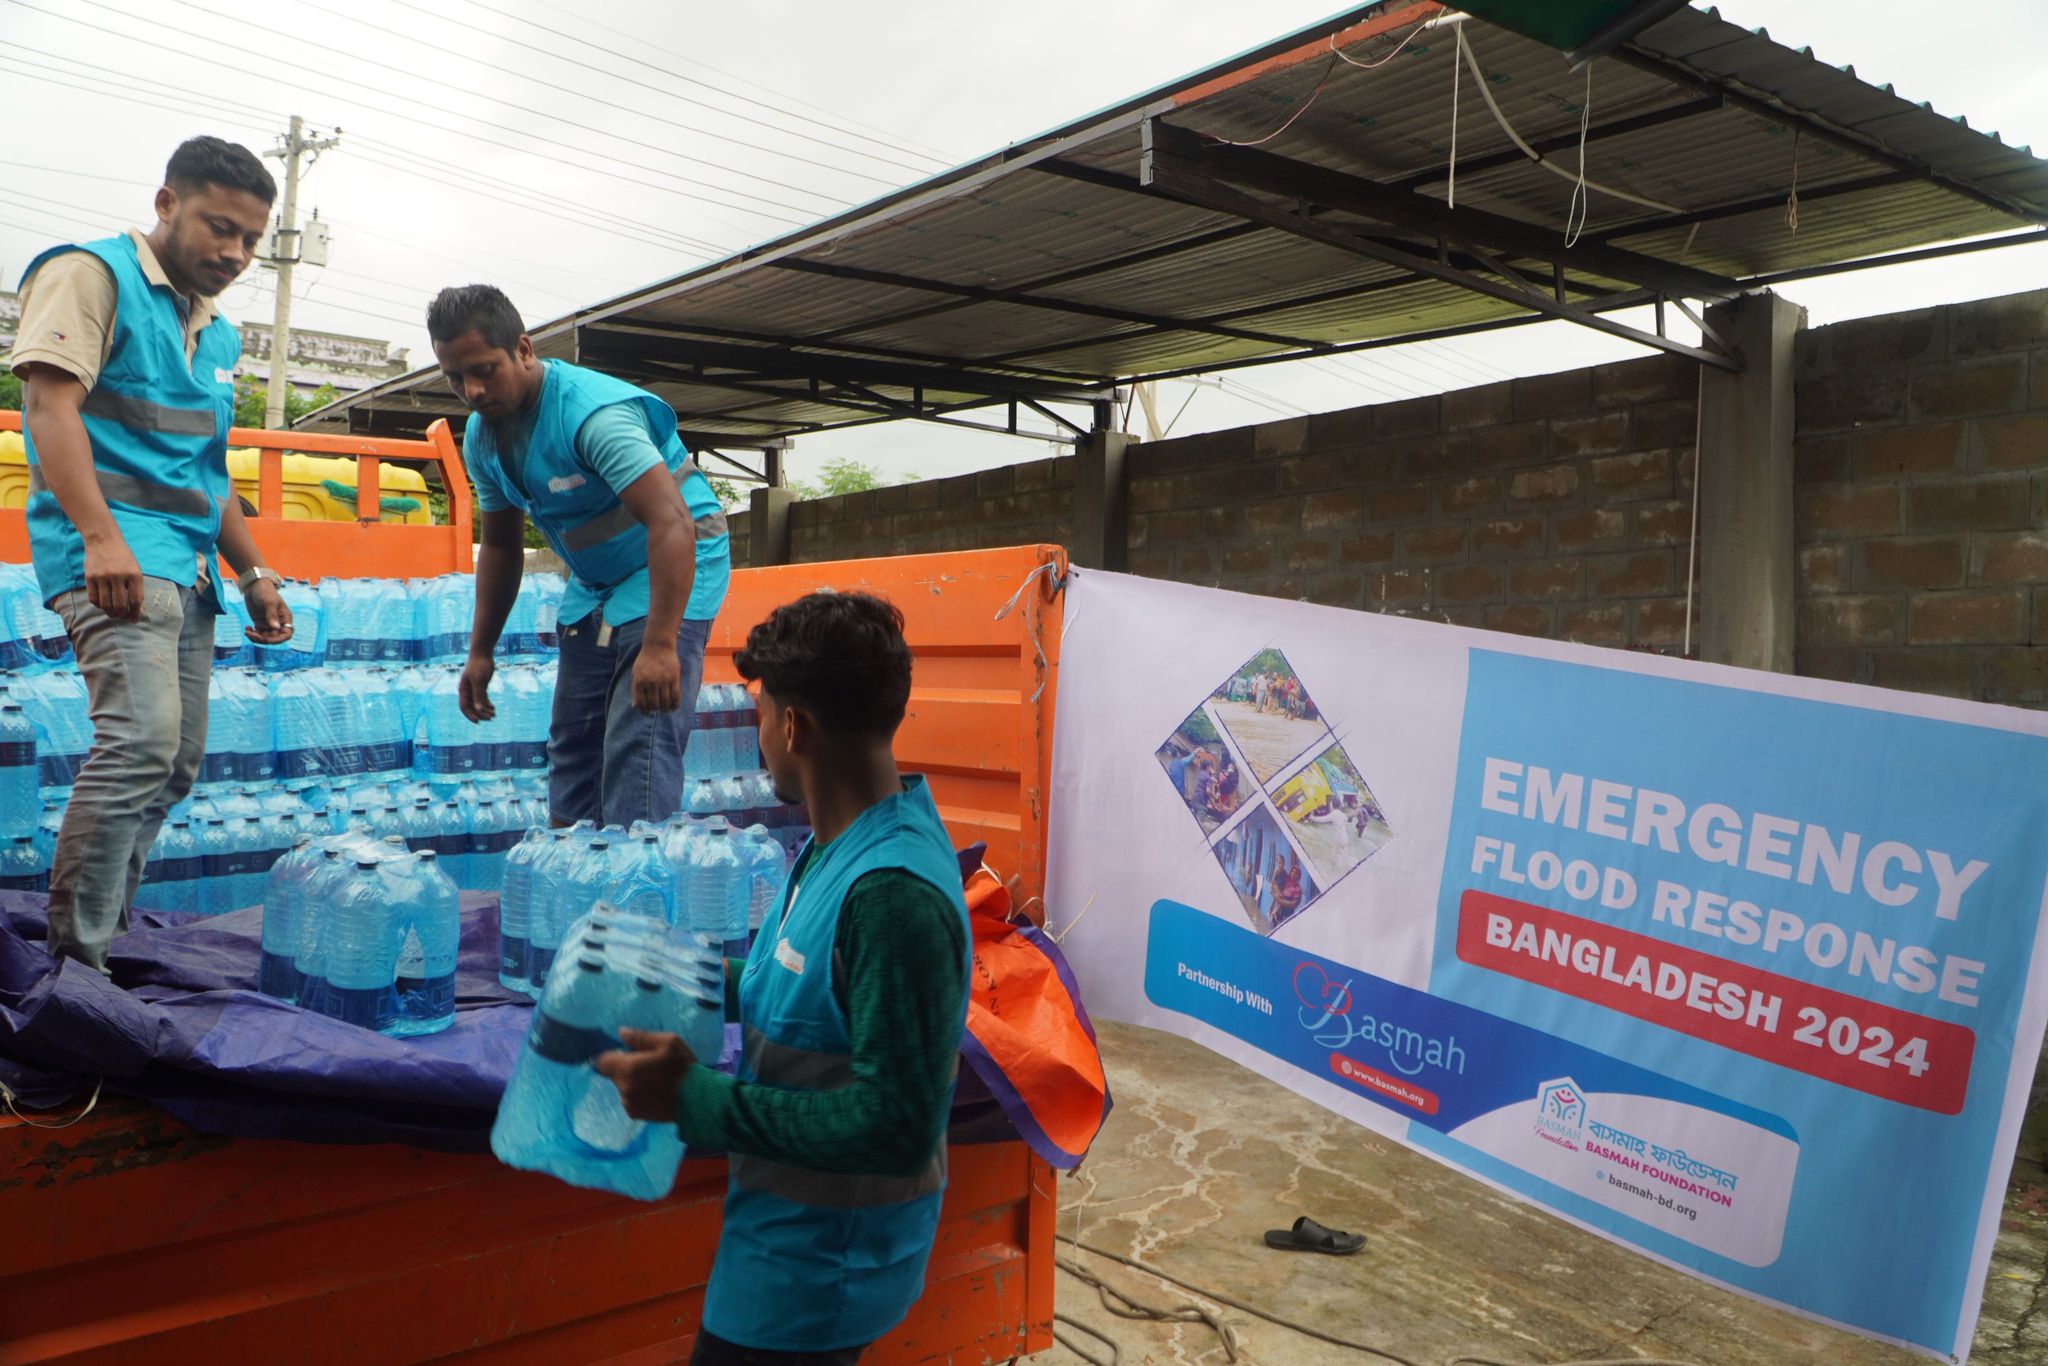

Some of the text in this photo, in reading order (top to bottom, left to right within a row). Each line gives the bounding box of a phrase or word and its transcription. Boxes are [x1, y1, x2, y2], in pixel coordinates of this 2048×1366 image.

[1482, 757, 1989, 922] EMERGENCY
[1471, 836, 1986, 1008] FLOOD RESPONSE
[1177, 962, 1273, 1016] Partnership With
[1293, 962, 1466, 1075] Basmah
[1486, 914, 1931, 1078] BANGLADESH 2024
[1353, 1071, 1425, 1106] www.basmah.org
[1536, 1115, 1582, 1142] BASMAH
[1589, 1120, 1647, 1159] বাসমাহ
[1586, 1141, 1733, 1208] BASMAH FOUNDATION
[1608, 1174, 1697, 1221] basmah-bd.org
